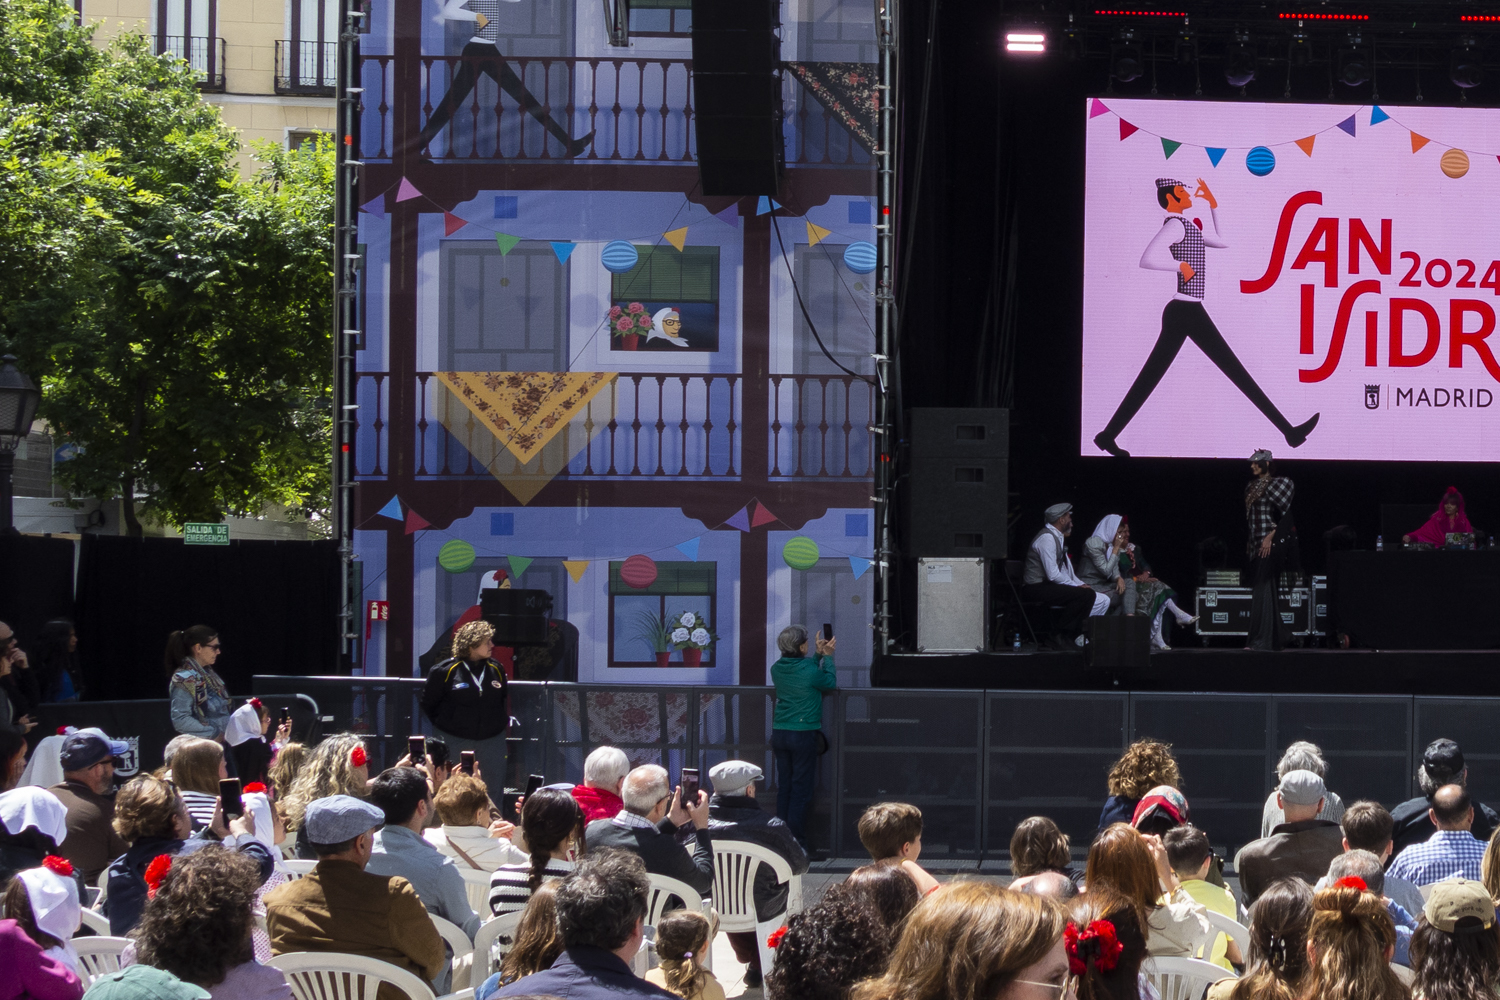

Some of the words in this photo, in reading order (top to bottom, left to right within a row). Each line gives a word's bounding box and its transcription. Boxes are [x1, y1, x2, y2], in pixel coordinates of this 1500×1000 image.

[1240, 190, 1393, 294] SAN
[1396, 387, 1494, 408] MADRID
[186, 525, 213, 534] SALIDA
[216, 526, 227, 534] DE
[186, 534, 228, 542] EMERGENCIA
